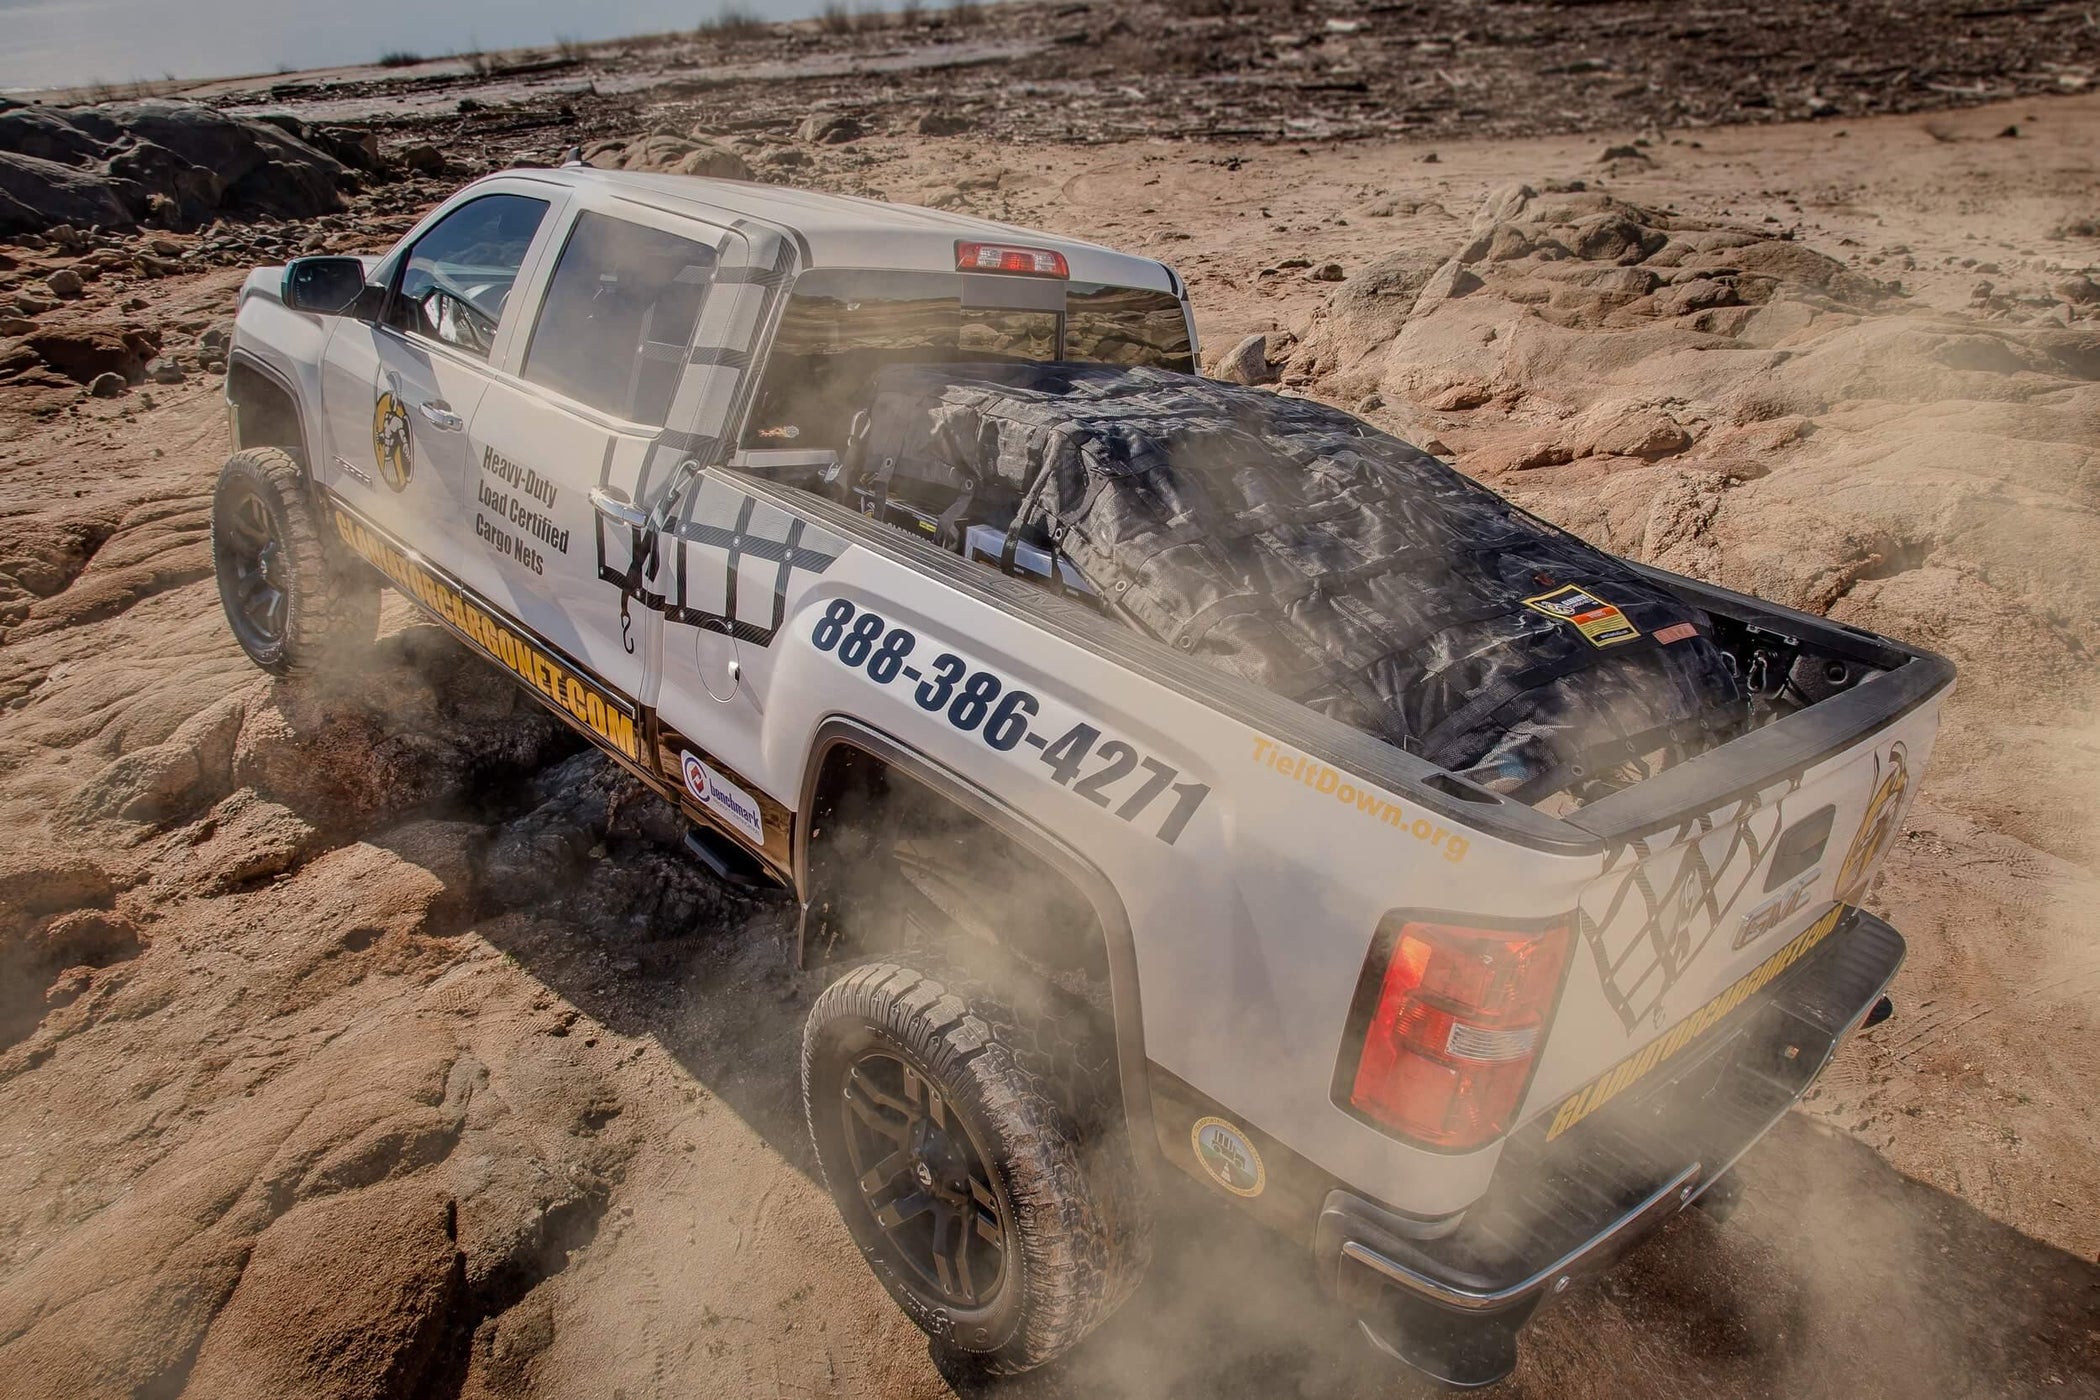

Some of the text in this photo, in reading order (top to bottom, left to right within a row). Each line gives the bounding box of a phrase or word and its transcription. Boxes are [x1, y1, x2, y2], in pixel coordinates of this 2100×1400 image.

[482, 444, 558, 510] Heavy-Duty
[475, 512, 544, 576] Cargo Nets
[478, 478, 570, 555] Load Certified
[335, 510, 637, 760] GLADIATORCARGONET.COM
[811, 598, 1212, 847] 888-386-4271
[708, 777, 760, 830] benchmark
[1252, 737, 1471, 864] TieItDown.org
